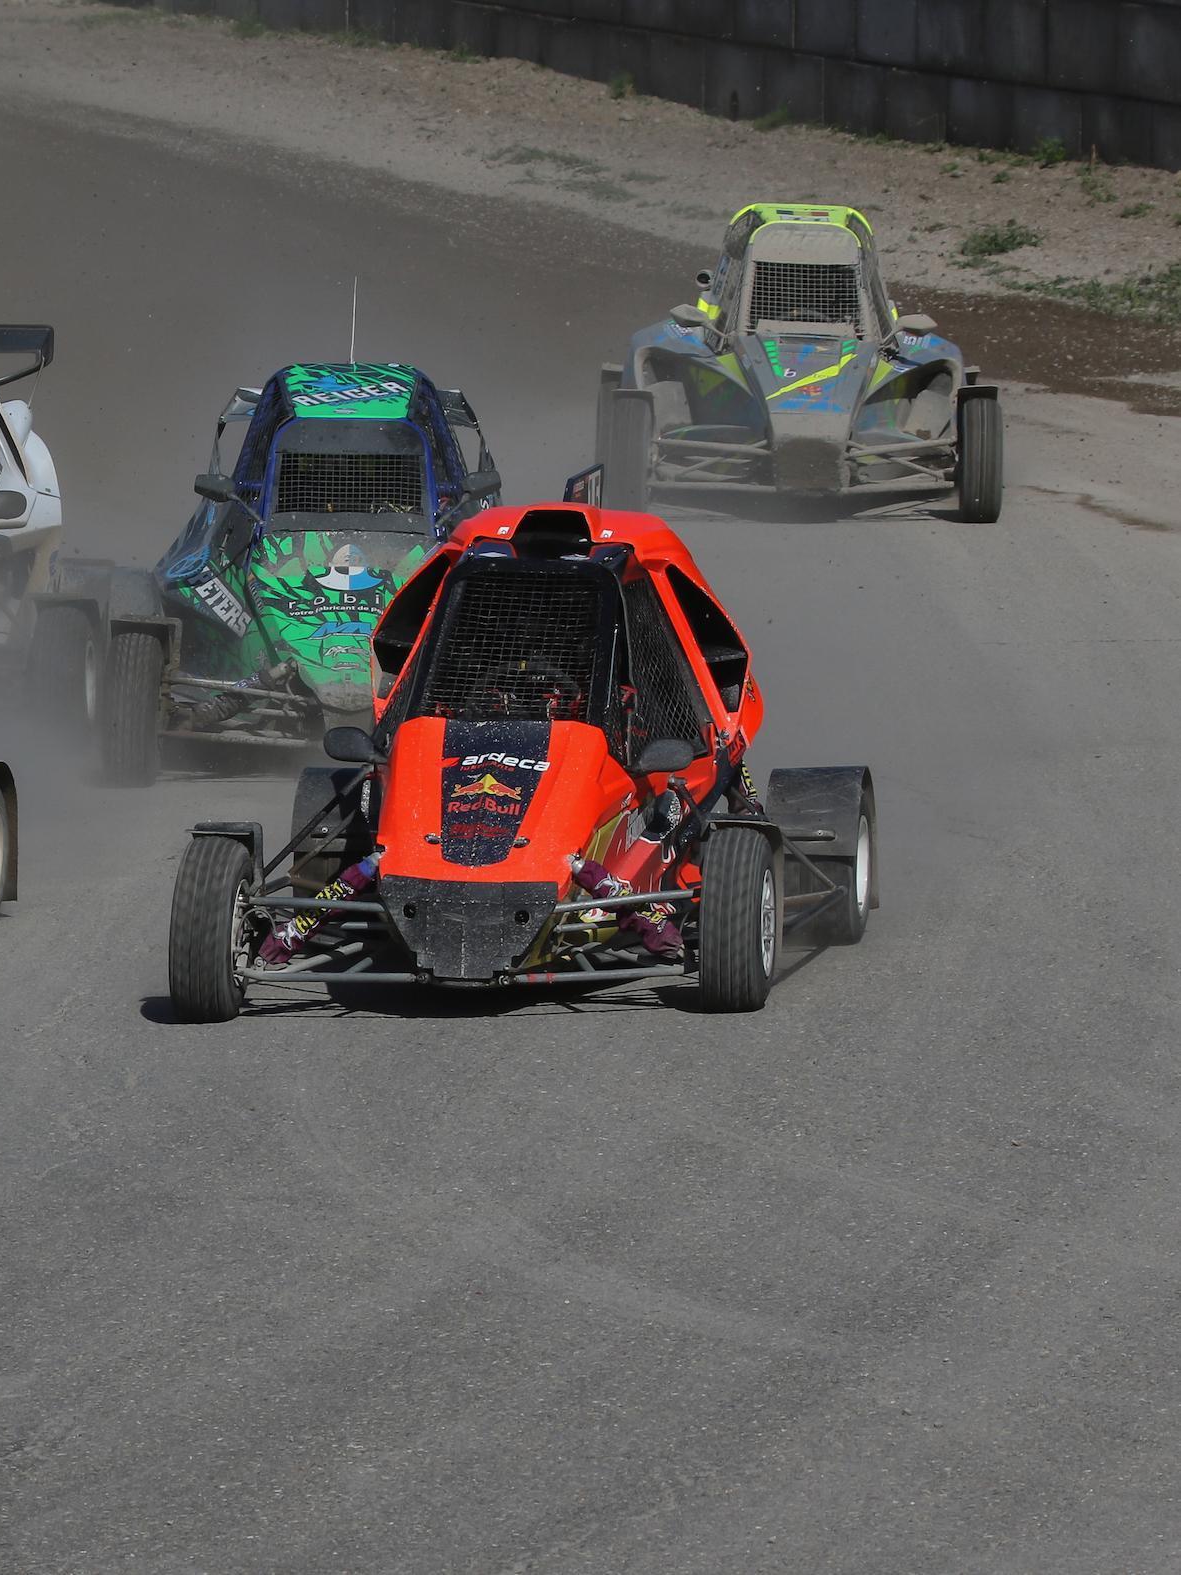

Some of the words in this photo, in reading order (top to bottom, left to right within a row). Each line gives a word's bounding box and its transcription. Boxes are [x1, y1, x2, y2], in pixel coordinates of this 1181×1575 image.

[292, 381, 409, 406] REIGER
[315, 605, 355, 613] fabricant
[461, 752, 551, 772] ardeca
[447, 798, 483, 813] Red
[484, 797, 520, 816] Bull
